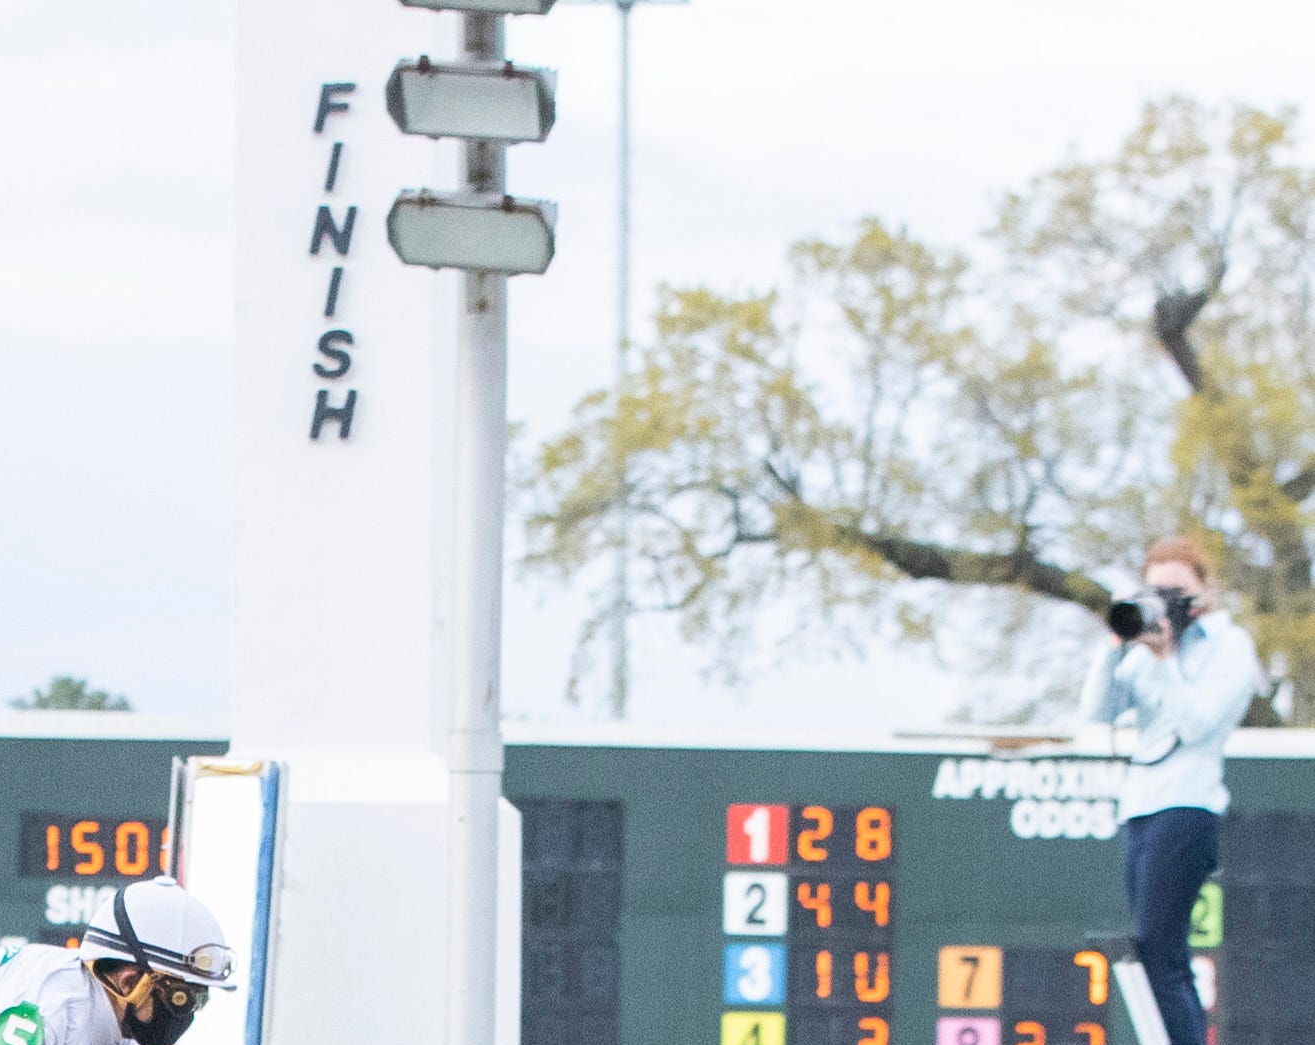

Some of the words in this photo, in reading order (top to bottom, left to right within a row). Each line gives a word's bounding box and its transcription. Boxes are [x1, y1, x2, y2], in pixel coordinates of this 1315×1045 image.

[310, 82, 358, 441] FINISH
[743, 807, 771, 863] 1
[1009, 799, 1119, 840] ODDS
[745, 882, 767, 925] 2
[738, 945, 772, 1000] 3
[959, 956, 981, 1005] 7
[1073, 950, 1109, 1006] 7
